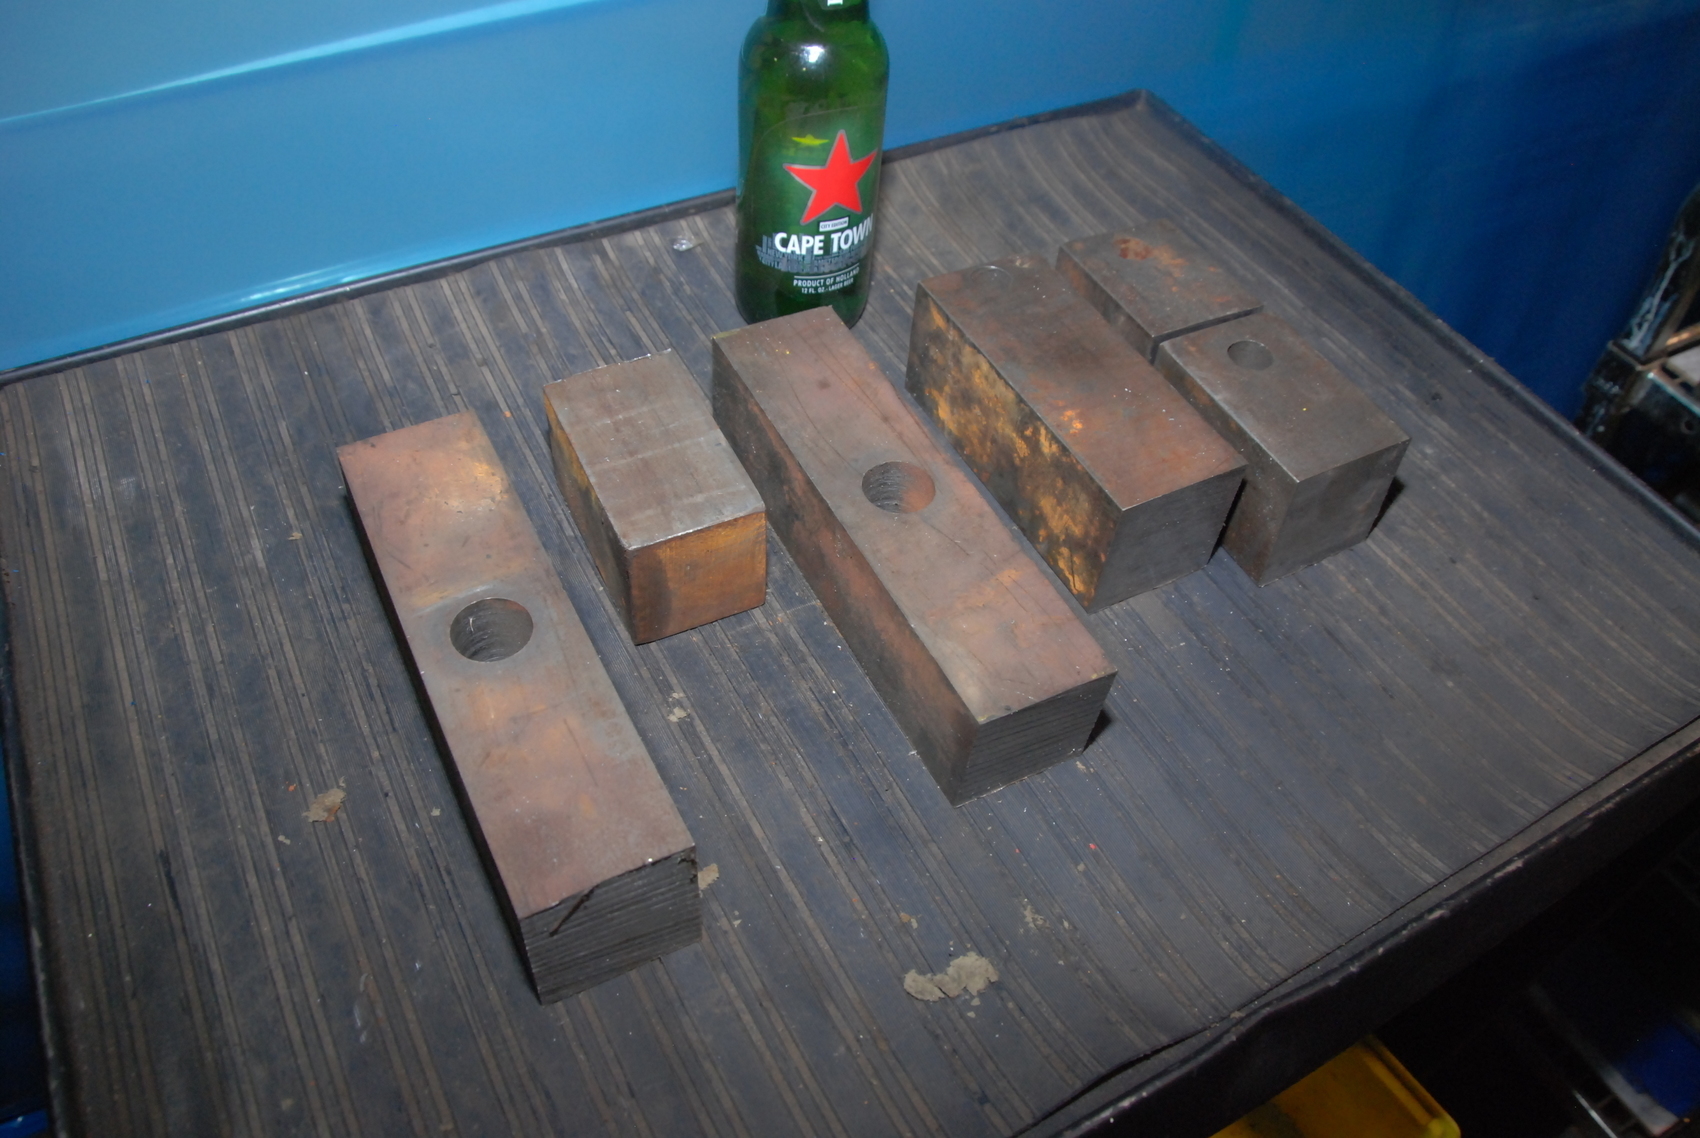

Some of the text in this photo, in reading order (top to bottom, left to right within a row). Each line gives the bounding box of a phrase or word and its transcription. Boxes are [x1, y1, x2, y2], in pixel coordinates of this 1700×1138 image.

[774, 232, 825, 255] CAPE
[831, 213, 873, 253] TOWN
[793, 279, 824, 287] PRODUCT
[835, 267, 859, 283] HOLLAND
[829, 282, 843, 291] LAGER
